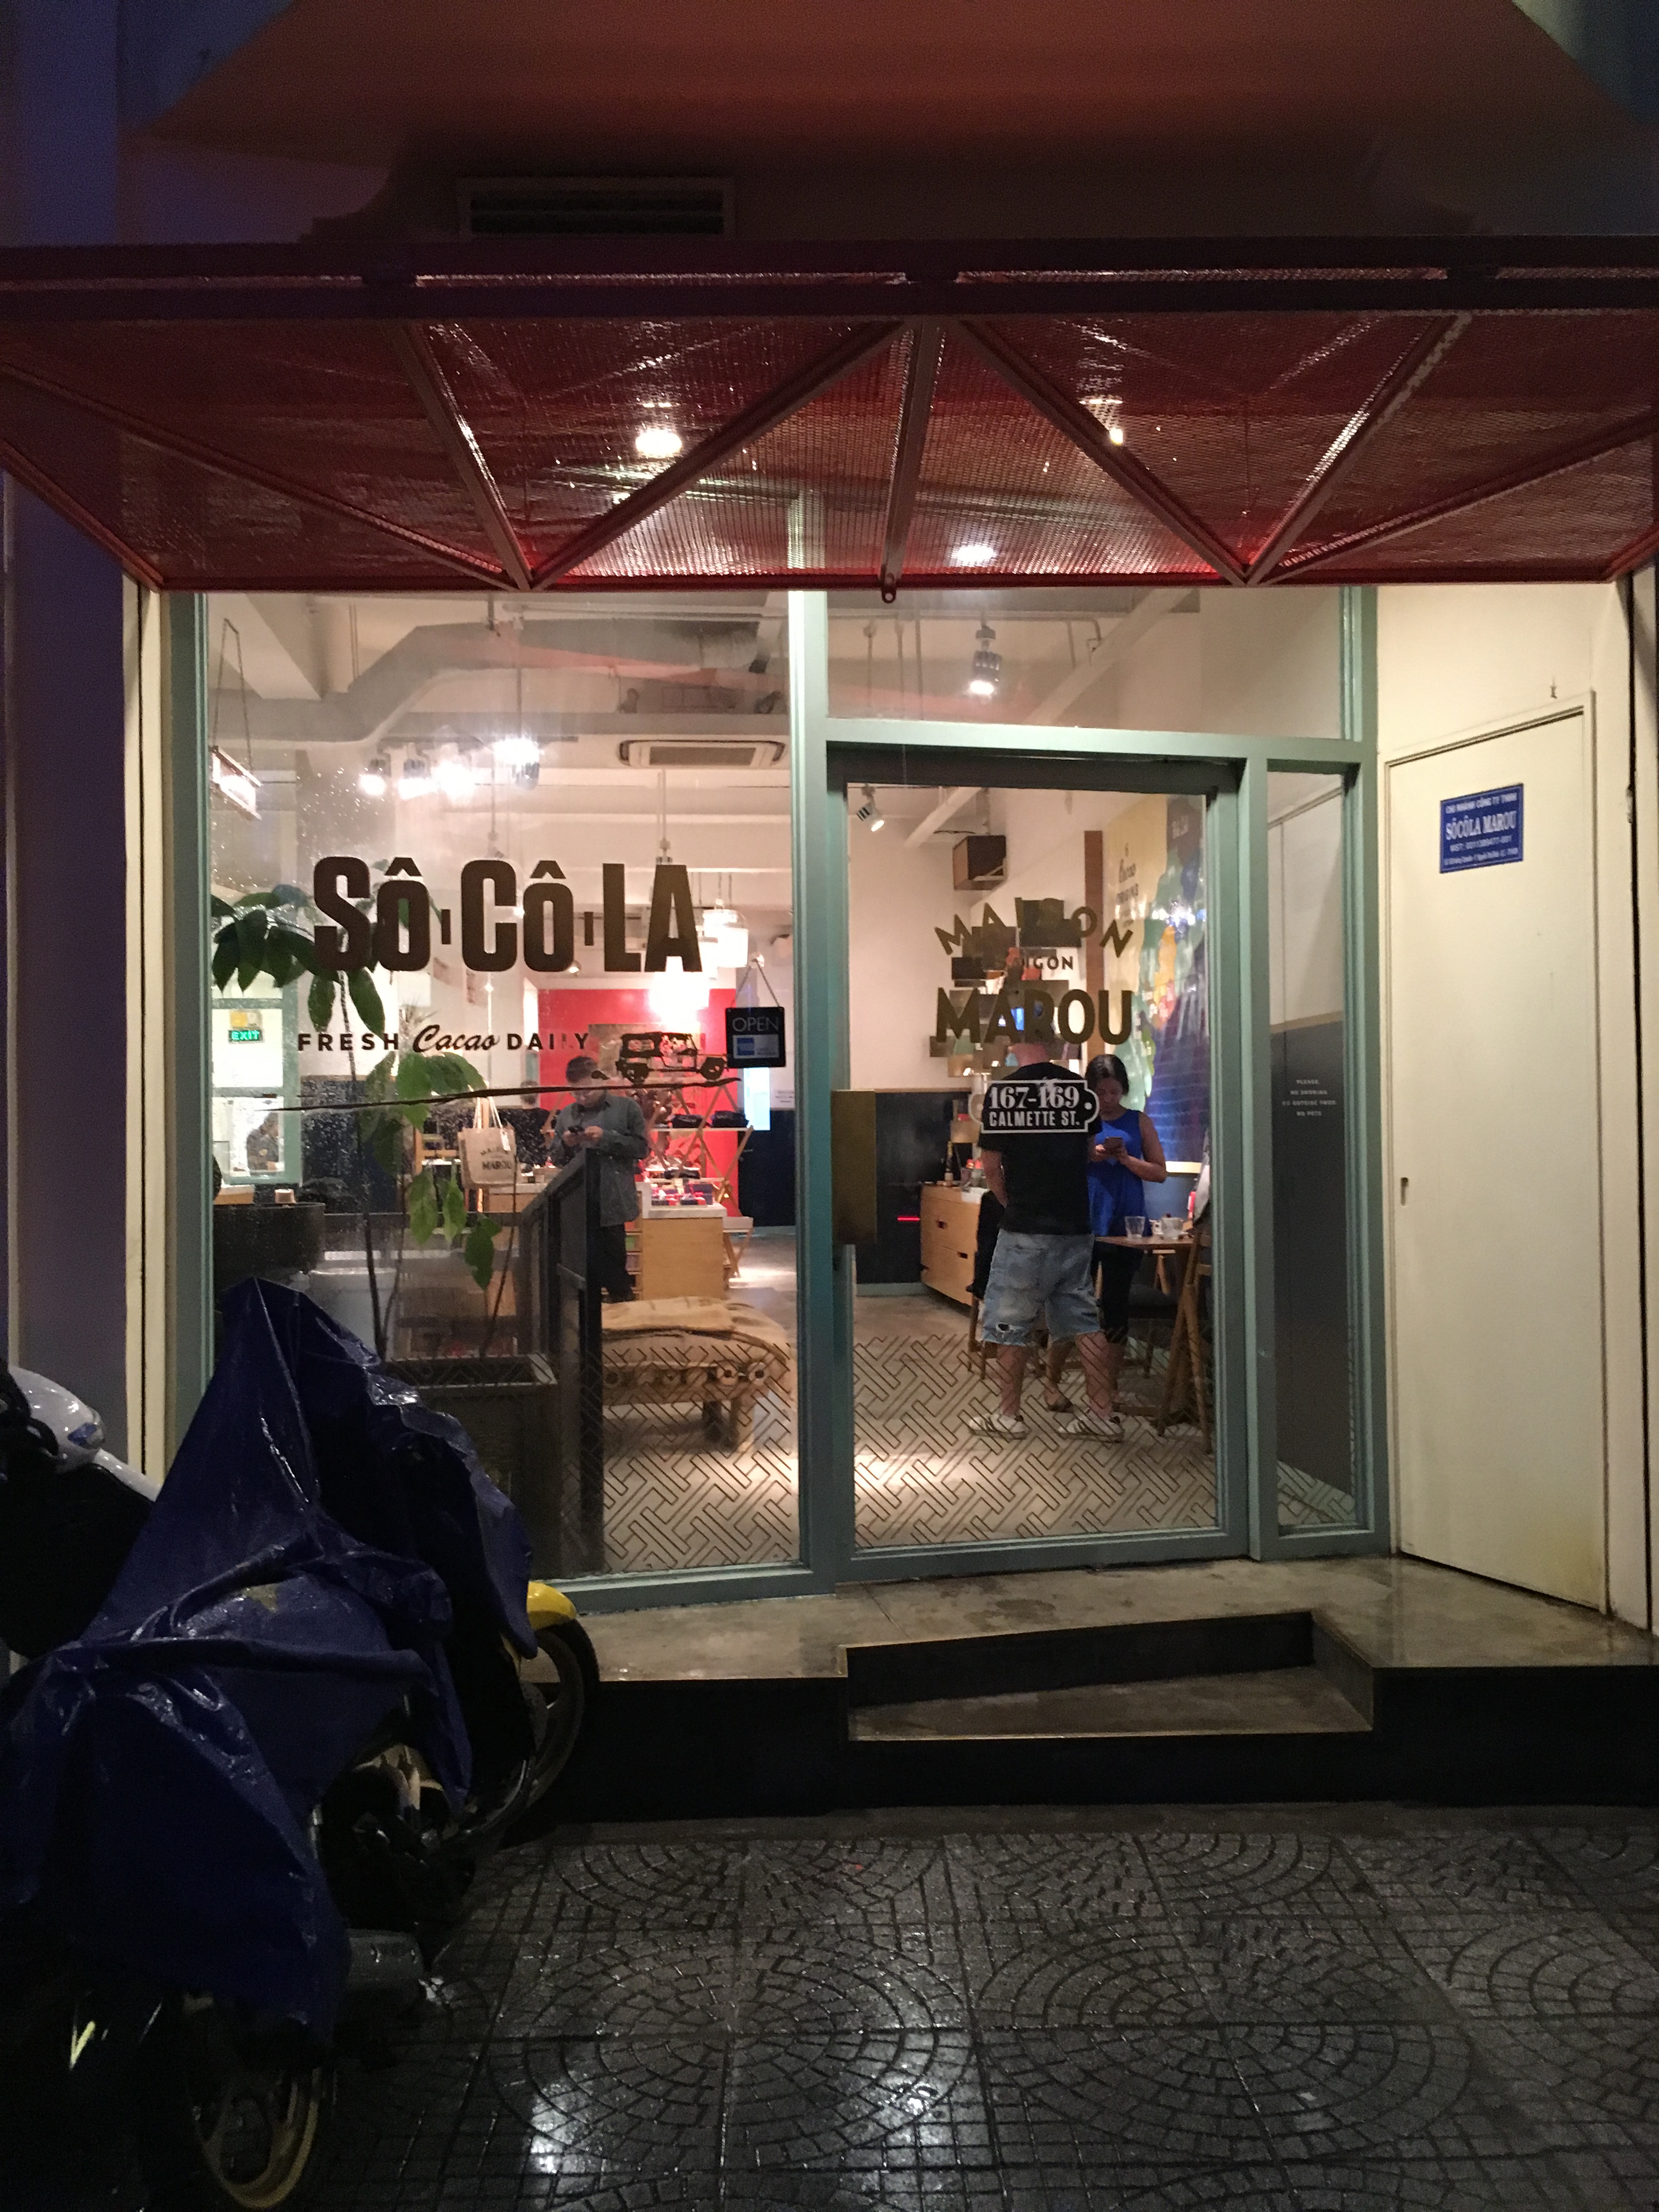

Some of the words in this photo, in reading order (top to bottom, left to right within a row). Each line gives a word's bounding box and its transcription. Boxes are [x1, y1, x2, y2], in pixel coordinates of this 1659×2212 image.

[732, 1017, 779, 1032] OPEN
[935, 987, 1133, 1045] MAROU
[232, 1030, 259, 1040] EXIT
[298, 1033, 399, 1051] FRESH
[413, 1024, 500, 1053] Cacao
[989, 1085, 1080, 1109] 167-169
[989, 1111, 1056, 1127] CALMETTE
[1061, 1110, 1080, 1126] ST.
